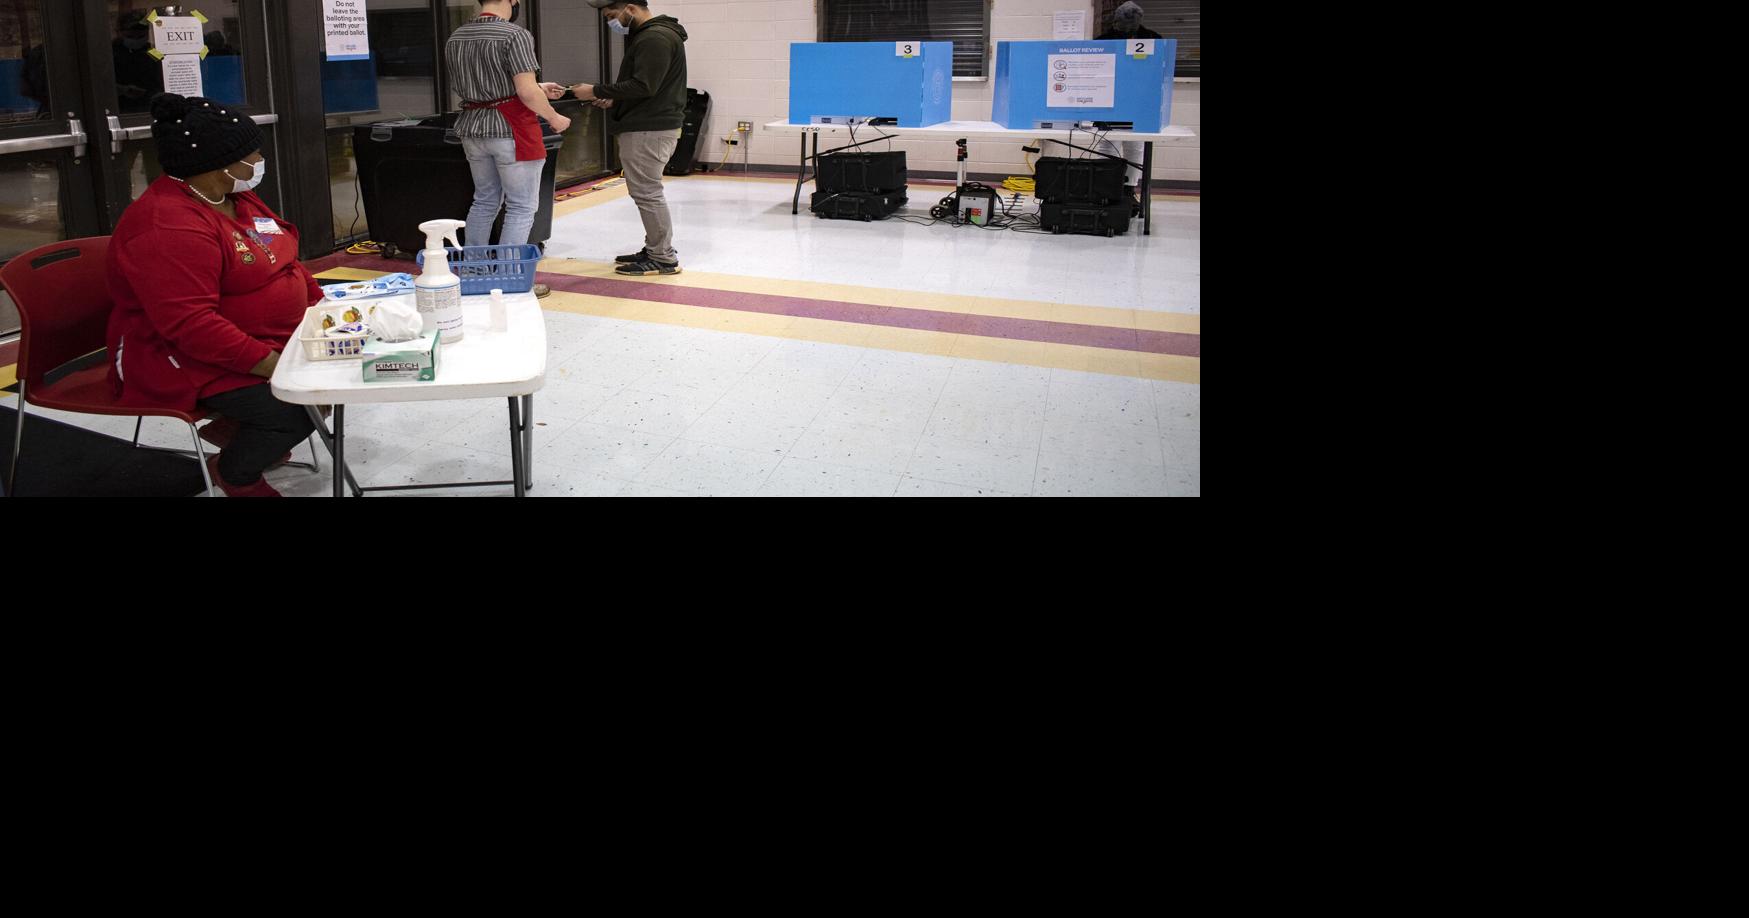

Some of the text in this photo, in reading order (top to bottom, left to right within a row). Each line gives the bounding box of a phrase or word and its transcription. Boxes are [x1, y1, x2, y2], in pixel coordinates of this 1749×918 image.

[167, 32, 194, 41] EXIT
[903, 45, 912, 54] 3
[1135, 42, 1145, 52] 2
